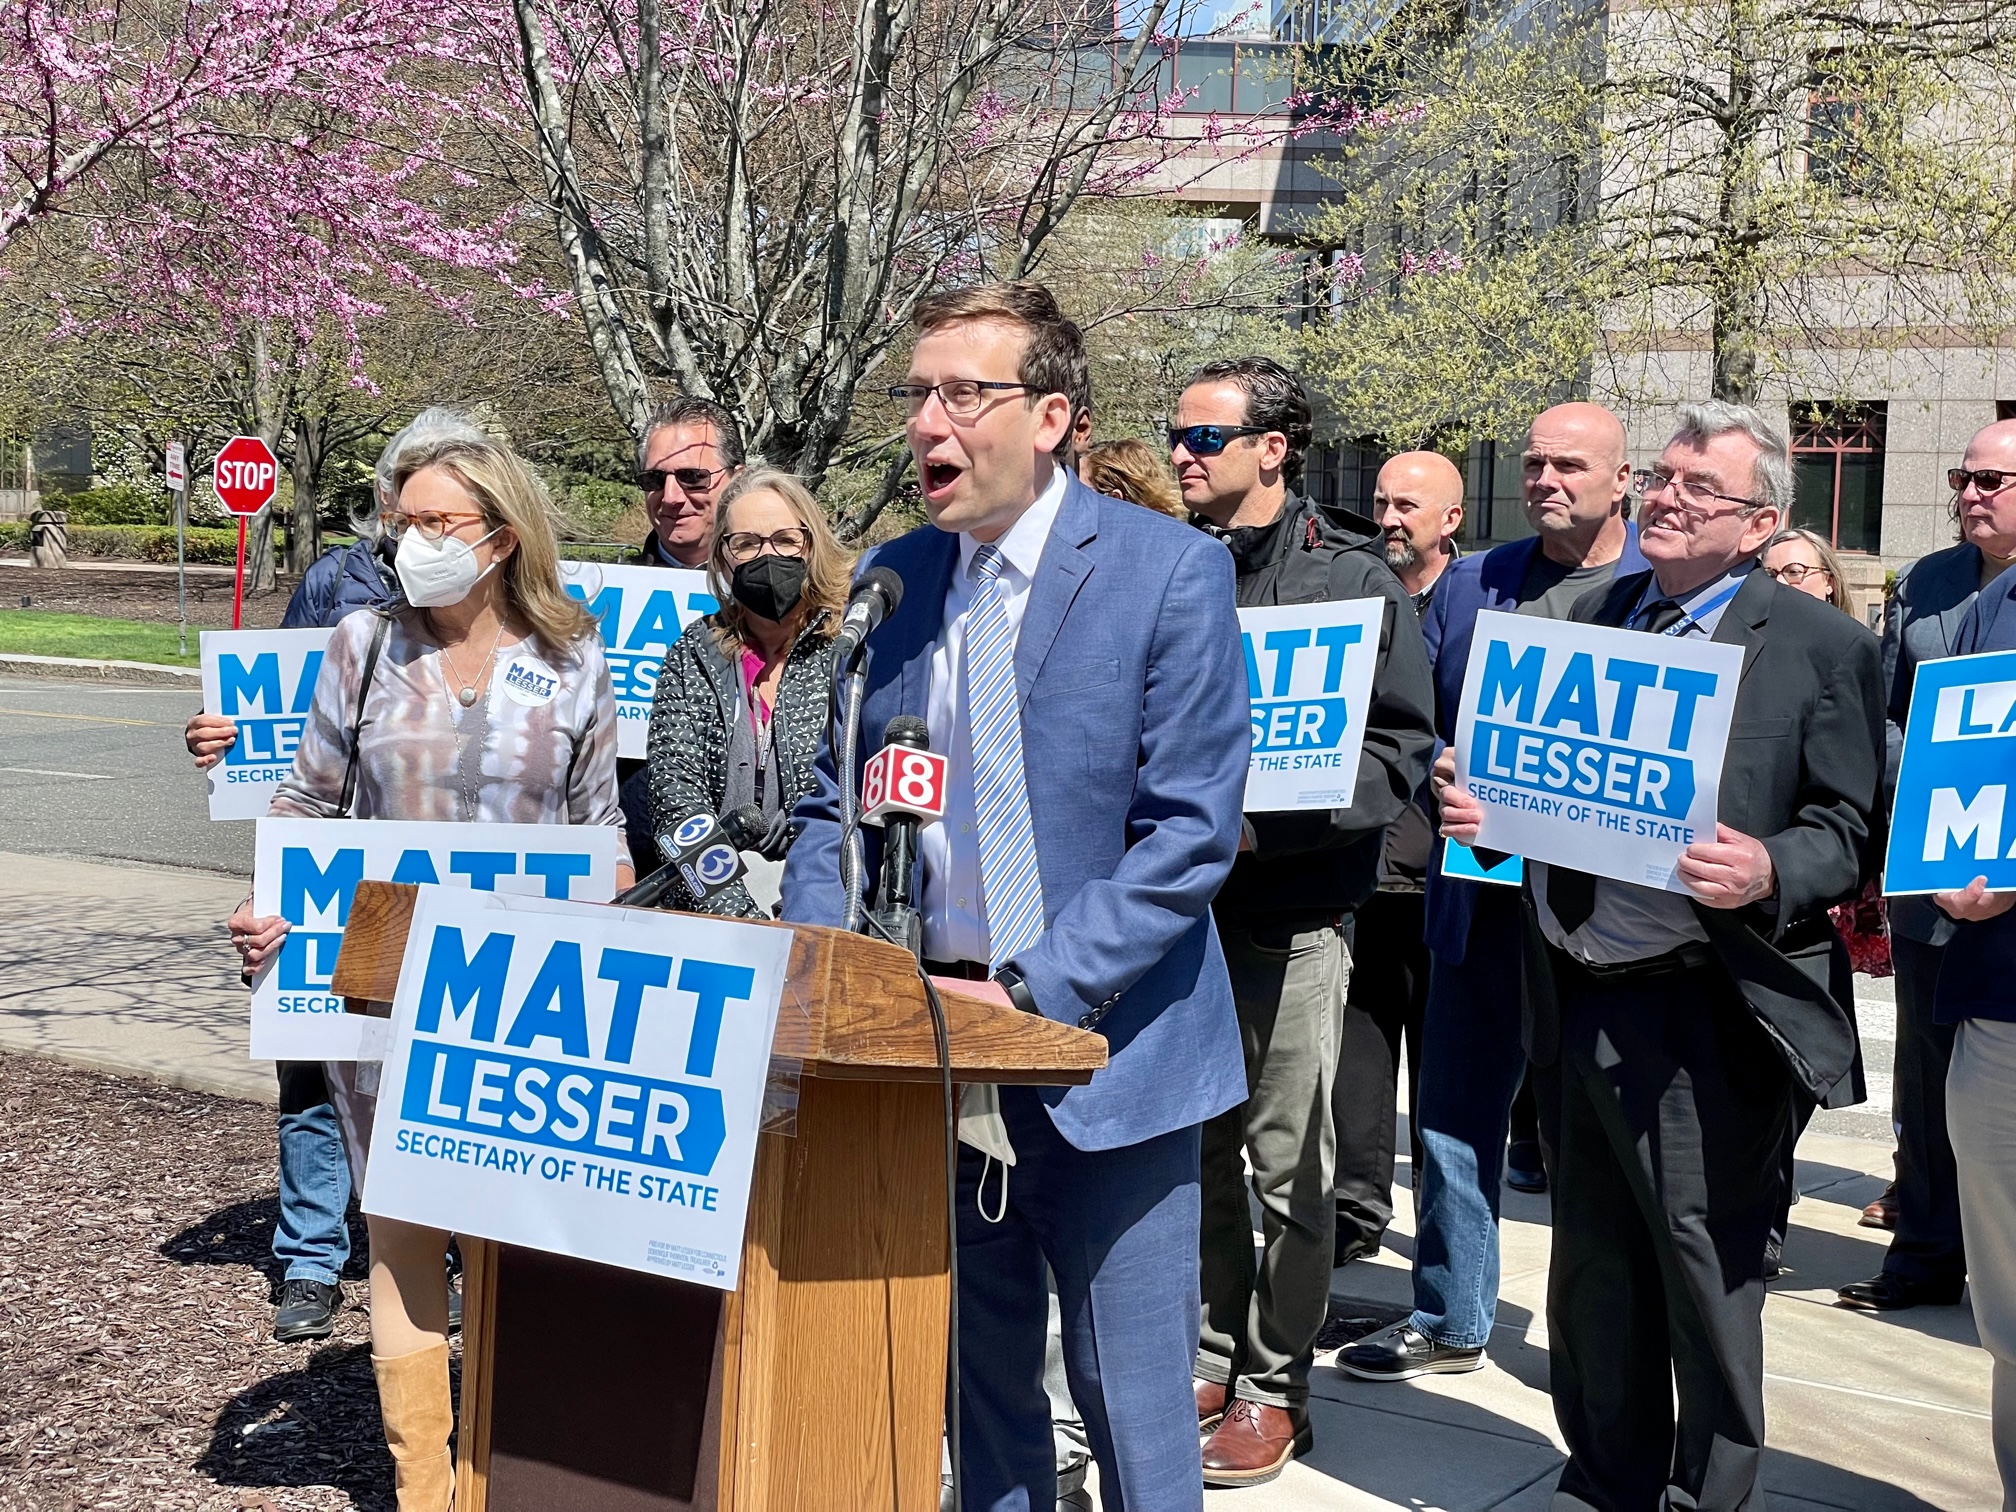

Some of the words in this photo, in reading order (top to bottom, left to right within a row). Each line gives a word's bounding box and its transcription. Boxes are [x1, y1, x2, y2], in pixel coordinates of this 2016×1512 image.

[219, 460, 273, 490] STOP
[1661, 614, 1693, 636] YIST
[508, 674, 548, 697] LESSER
[509, 662, 557, 689] MATT
[1476, 639, 1719, 752] MATT
[866, 756, 884, 809] 8
[898, 754, 934, 806] 8
[1259, 756, 1289, 771] THE
[1292, 753, 1342, 769] STATE
[1486, 730, 1671, 811] LESSER
[1468, 783, 1563, 817] SECRETARY
[1567, 804, 1591, 823] OF
[1595, 809, 1631, 833] THE
[1635, 819, 1695, 845] STATE
[683, 865, 703, 895] wfsb.com
[278, 996, 347, 1013] SECR
[414, 925, 756, 1078] MATT
[426, 1052, 690, 1161] LESSER
[395, 1128, 536, 1176] SECRETARY
[540, 1156, 576, 1182] OF
[582, 1163, 632, 1195] THE
[638, 1174, 719, 1212] STATE
